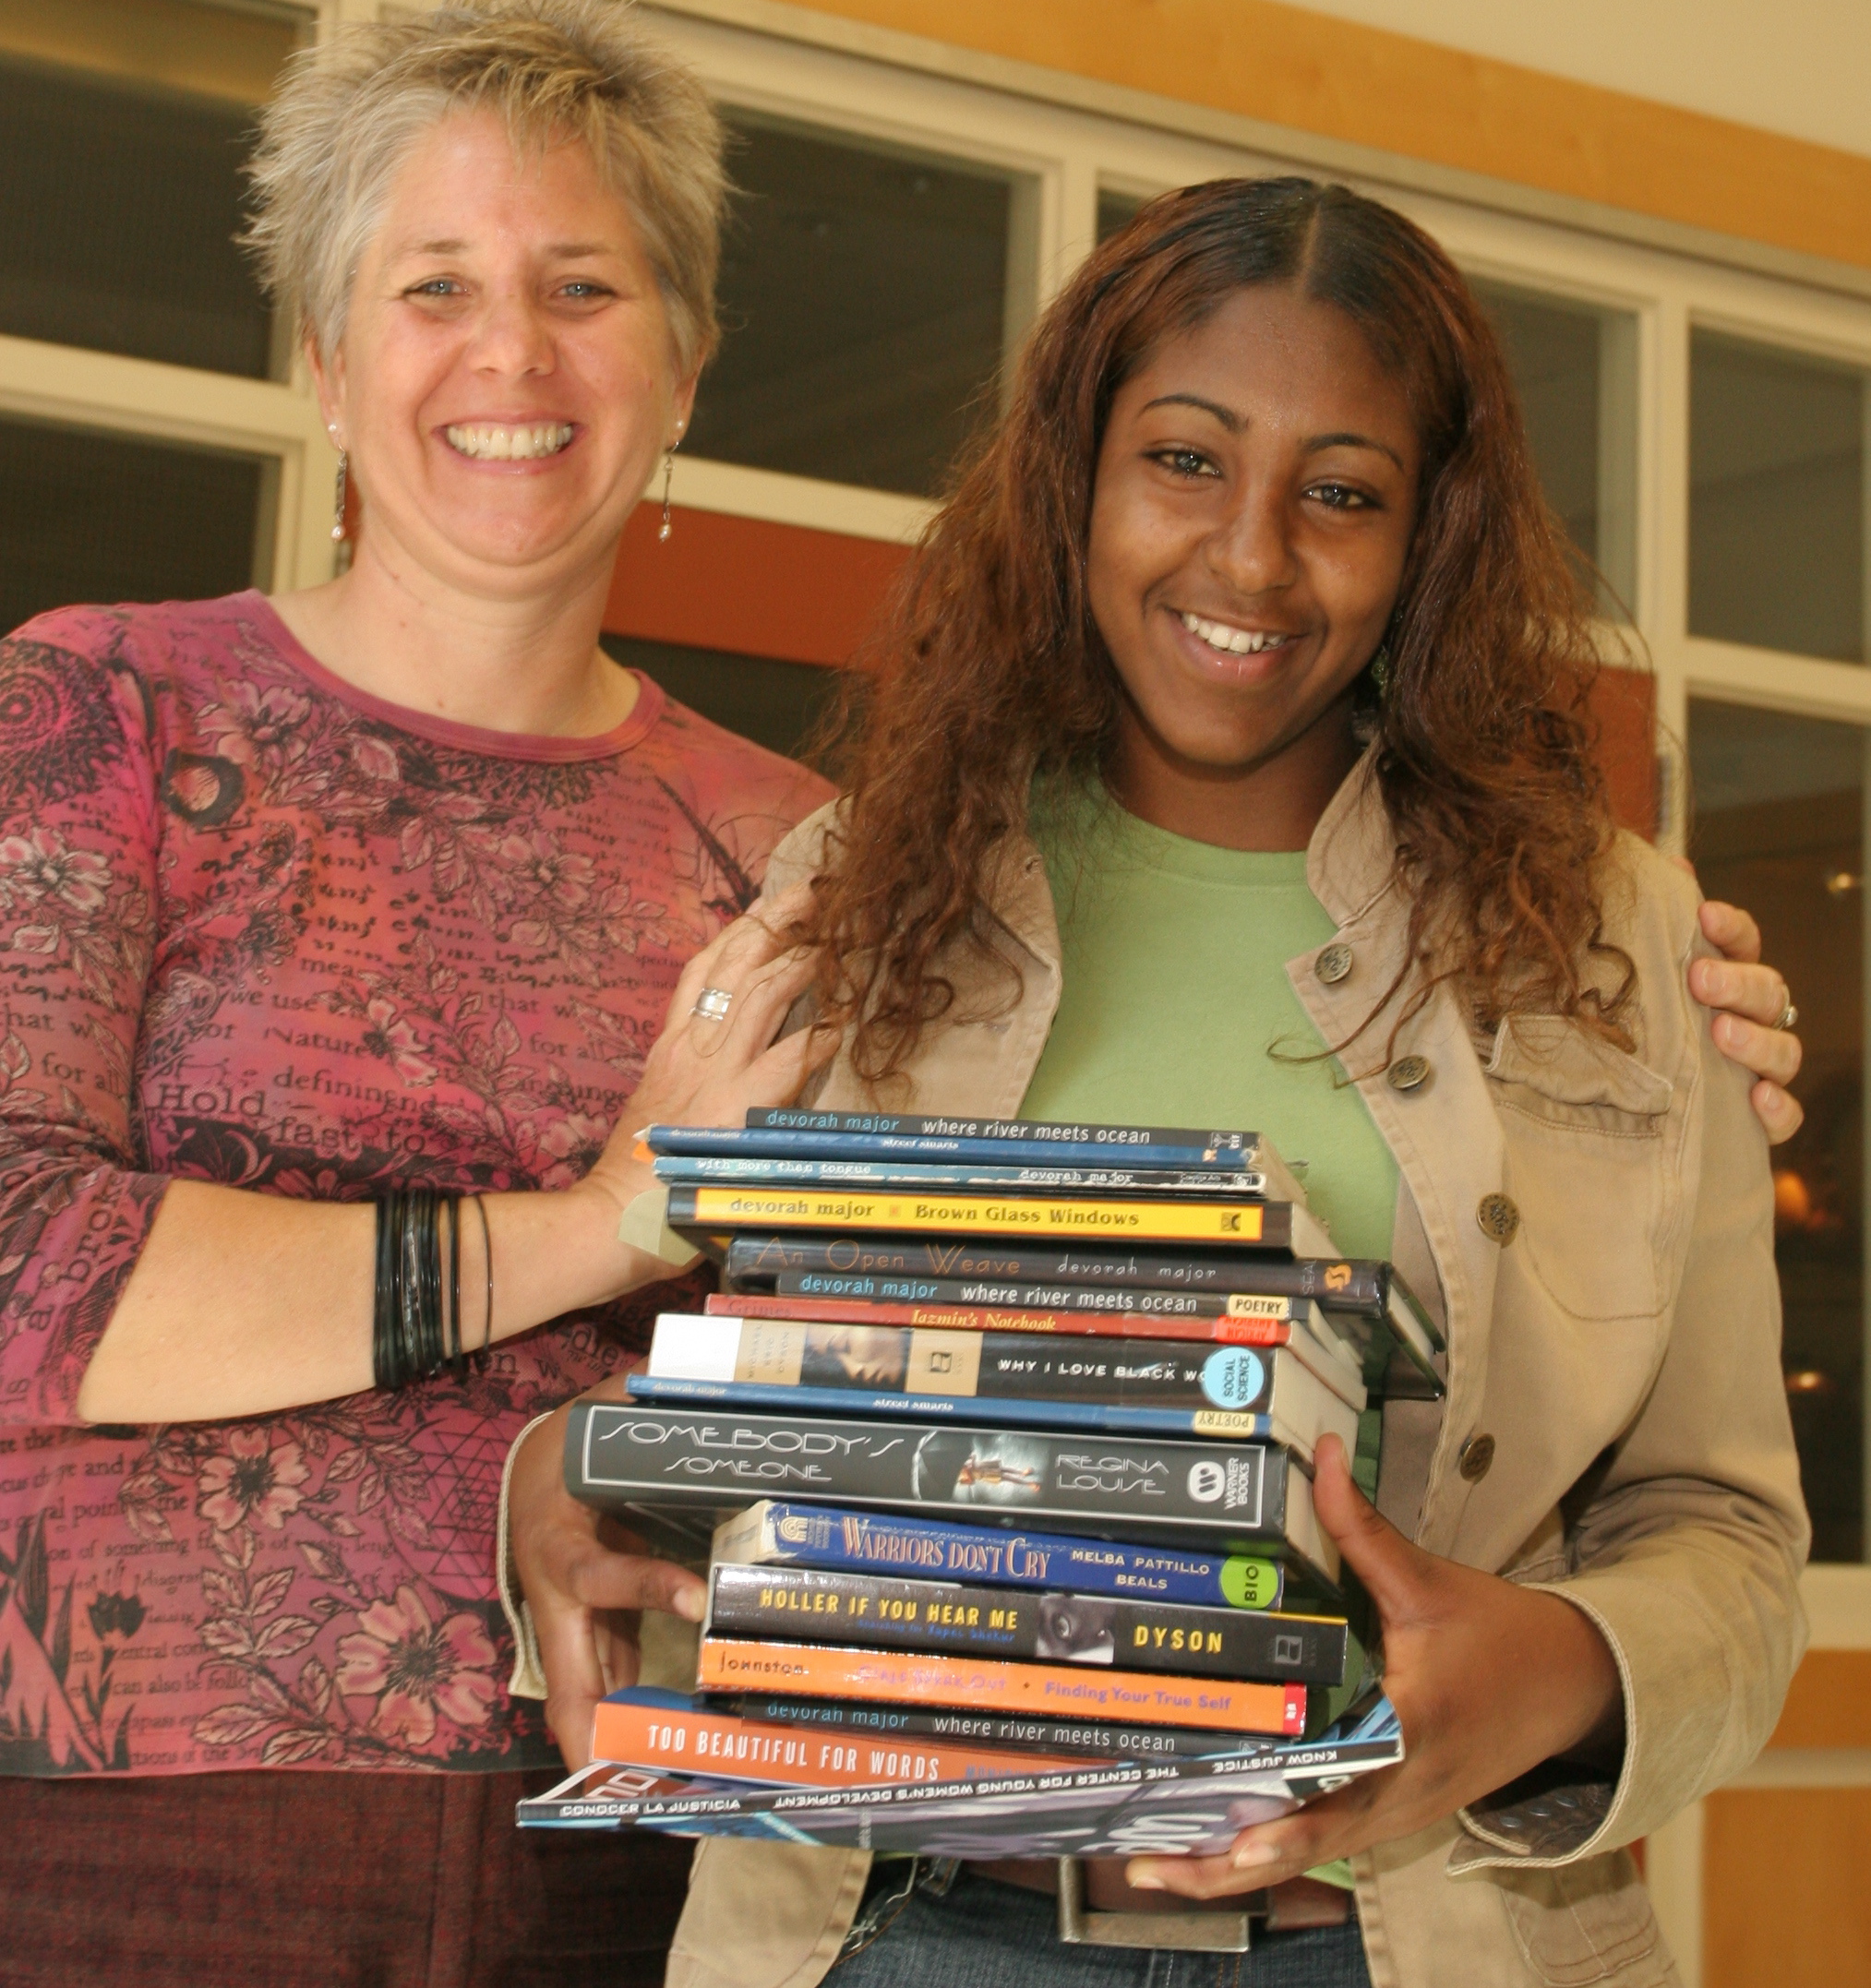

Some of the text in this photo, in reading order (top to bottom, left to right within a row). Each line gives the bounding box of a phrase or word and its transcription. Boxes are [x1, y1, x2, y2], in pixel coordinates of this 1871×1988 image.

[158, 1084, 266, 1117] Hold
[275, 1116, 426, 1154] fast to
[765, 1109, 1151, 1145] devorah major where river meets ocean
[695, 1158, 1134, 1184] with more than tongue devorah major
[730, 1197, 1140, 1227] devorah major Brown Glass Windows
[755, 1237, 1217, 1283] An Open Weave devorah major
[799, 1275, 1198, 1312] devorah major where river meets ocean
[1235, 1299, 1282, 1314] POETRY
[983, 1312, 1057, 1332] Notebook
[997, 1358, 1037, 1372] WHY
[1044, 1361, 1050, 1374] I
[1058, 1362, 1107, 1377] LOVE
[1114, 1365, 1176, 1381] BLACK
[1223, 1359, 1236, 1398] SOCIAL
[1237, 1354, 1251, 1402] SCIENCE
[872, 1396, 909, 1409] street
[910, 1400, 954, 1412] smarts
[1195, 1412, 1250, 1428] POETRY
[598, 1421, 905, 1458] SOMEBODY'S
[664, 1455, 833, 1483] SOMEONE
[1055, 1453, 1170, 1476] REGINA
[1055, 1475, 1167, 1496] LOUISE
[1224, 1456, 1240, 1511] WARNER
[1237, 1461, 1251, 1506] BOOKS
[841, 1515, 944, 1567] WARRIORS
[1006, 1536, 1051, 1579] CRY
[1071, 1550, 1211, 1576] MELBA PATTILLO
[1114, 1572, 1169, 1590] BEALS
[1243, 1563, 1259, 1602] BIO
[759, 1587, 1224, 1654] HOLLER IF YOU HEAR ME DYSON
[1044, 1681, 1108, 1705] Finding
[1111, 1687, 1150, 1707] Your
[1154, 1691, 1193, 1708] True
[1198, 1695, 1232, 1711] Self
[767, 1702, 1176, 1753] devorah major where river meets ocean
[646, 1723, 687, 1754] TOO
[697, 1731, 810, 1768] BEAUTIFUL
[819, 1743, 858, 1774] FOR
[869, 1749, 940, 1781] WORDS
[773, 1750, 1338, 1810] KNOW JUSTICE THE CENTER FOR YOUNG WOMEN'S DEVELOPMENT
[558, 1798, 741, 1817] CONOCER LA JUSTICIA
